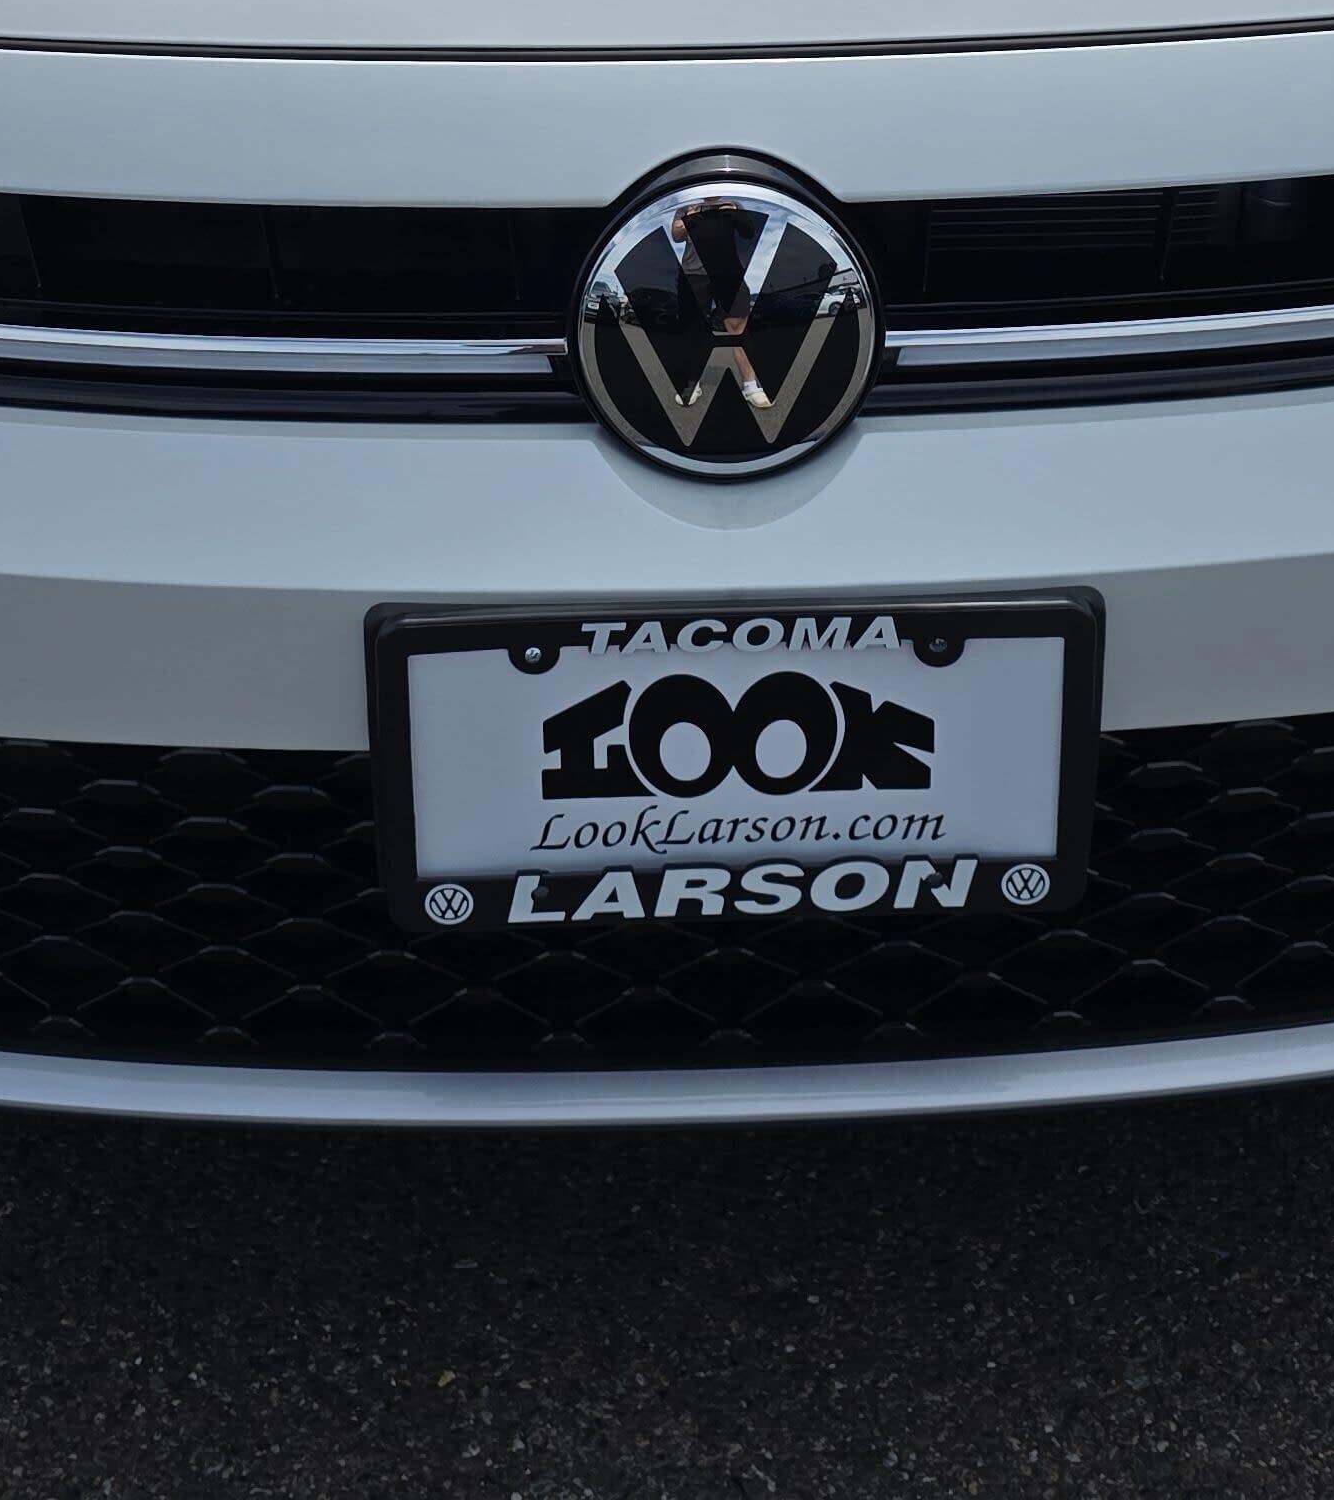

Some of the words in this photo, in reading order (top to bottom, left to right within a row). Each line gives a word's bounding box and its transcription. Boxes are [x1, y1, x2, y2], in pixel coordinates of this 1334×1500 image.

[581, 616, 901, 655] TACOMA
[541, 671, 935, 800] LOOK
[529, 805, 946, 854] LookLarson.com
[508, 861, 979, 923] LARSON
